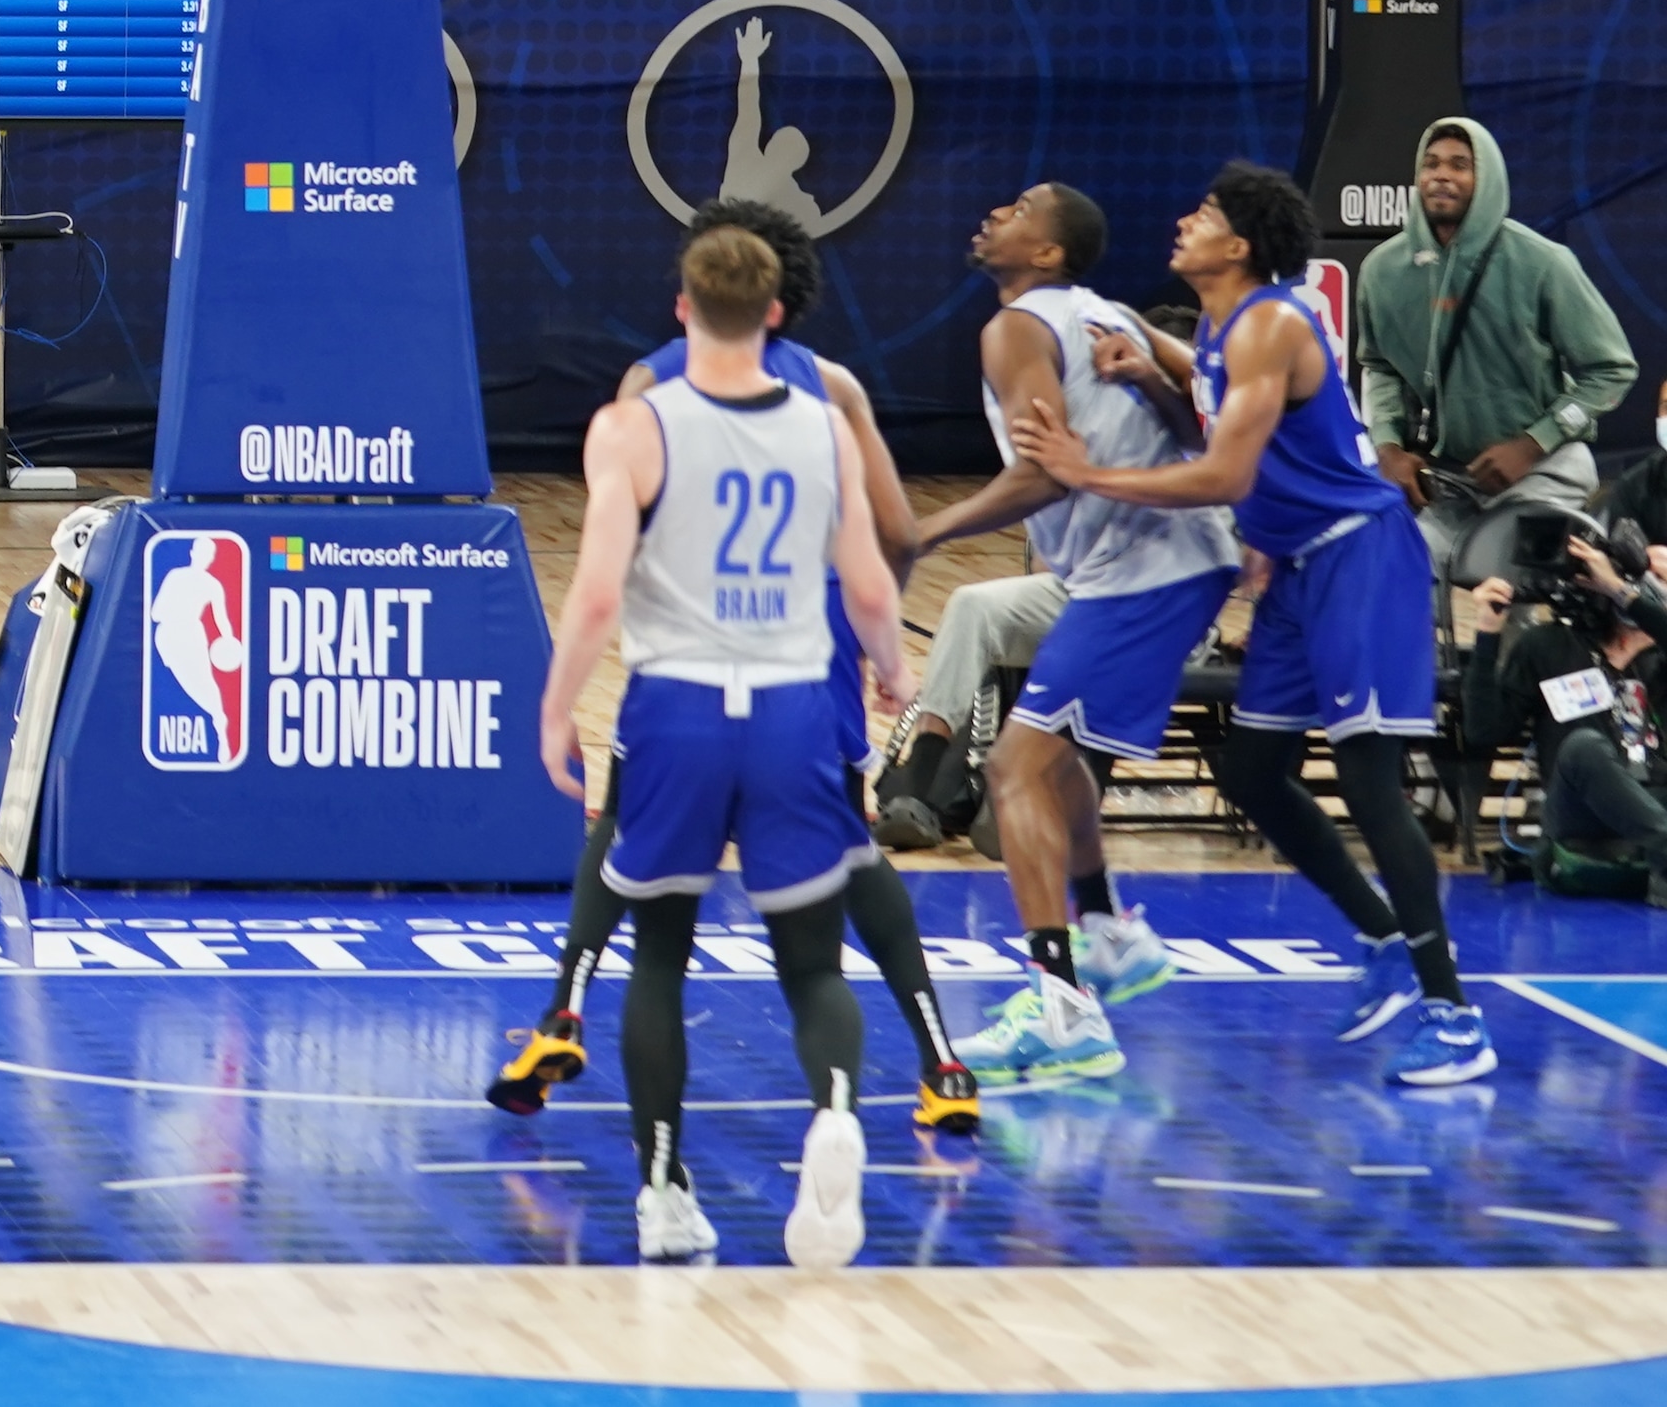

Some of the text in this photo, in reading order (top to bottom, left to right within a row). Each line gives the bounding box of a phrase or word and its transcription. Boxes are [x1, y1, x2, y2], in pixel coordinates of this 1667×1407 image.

[1386, 0, 1440, 14] Surface
[303, 162, 417, 187] Microsoft
[303, 190, 394, 212] Surface
[240, 425, 415, 485] @NBADraft
[713, 469, 796, 578] 22
[310, 543, 509, 570] Microsoft Surface
[715, 588, 788, 622] BRAUN
[269, 587, 432, 679] DRAFT
[158, 715, 208, 755] NBA
[267, 679, 502, 769] COMBINE
